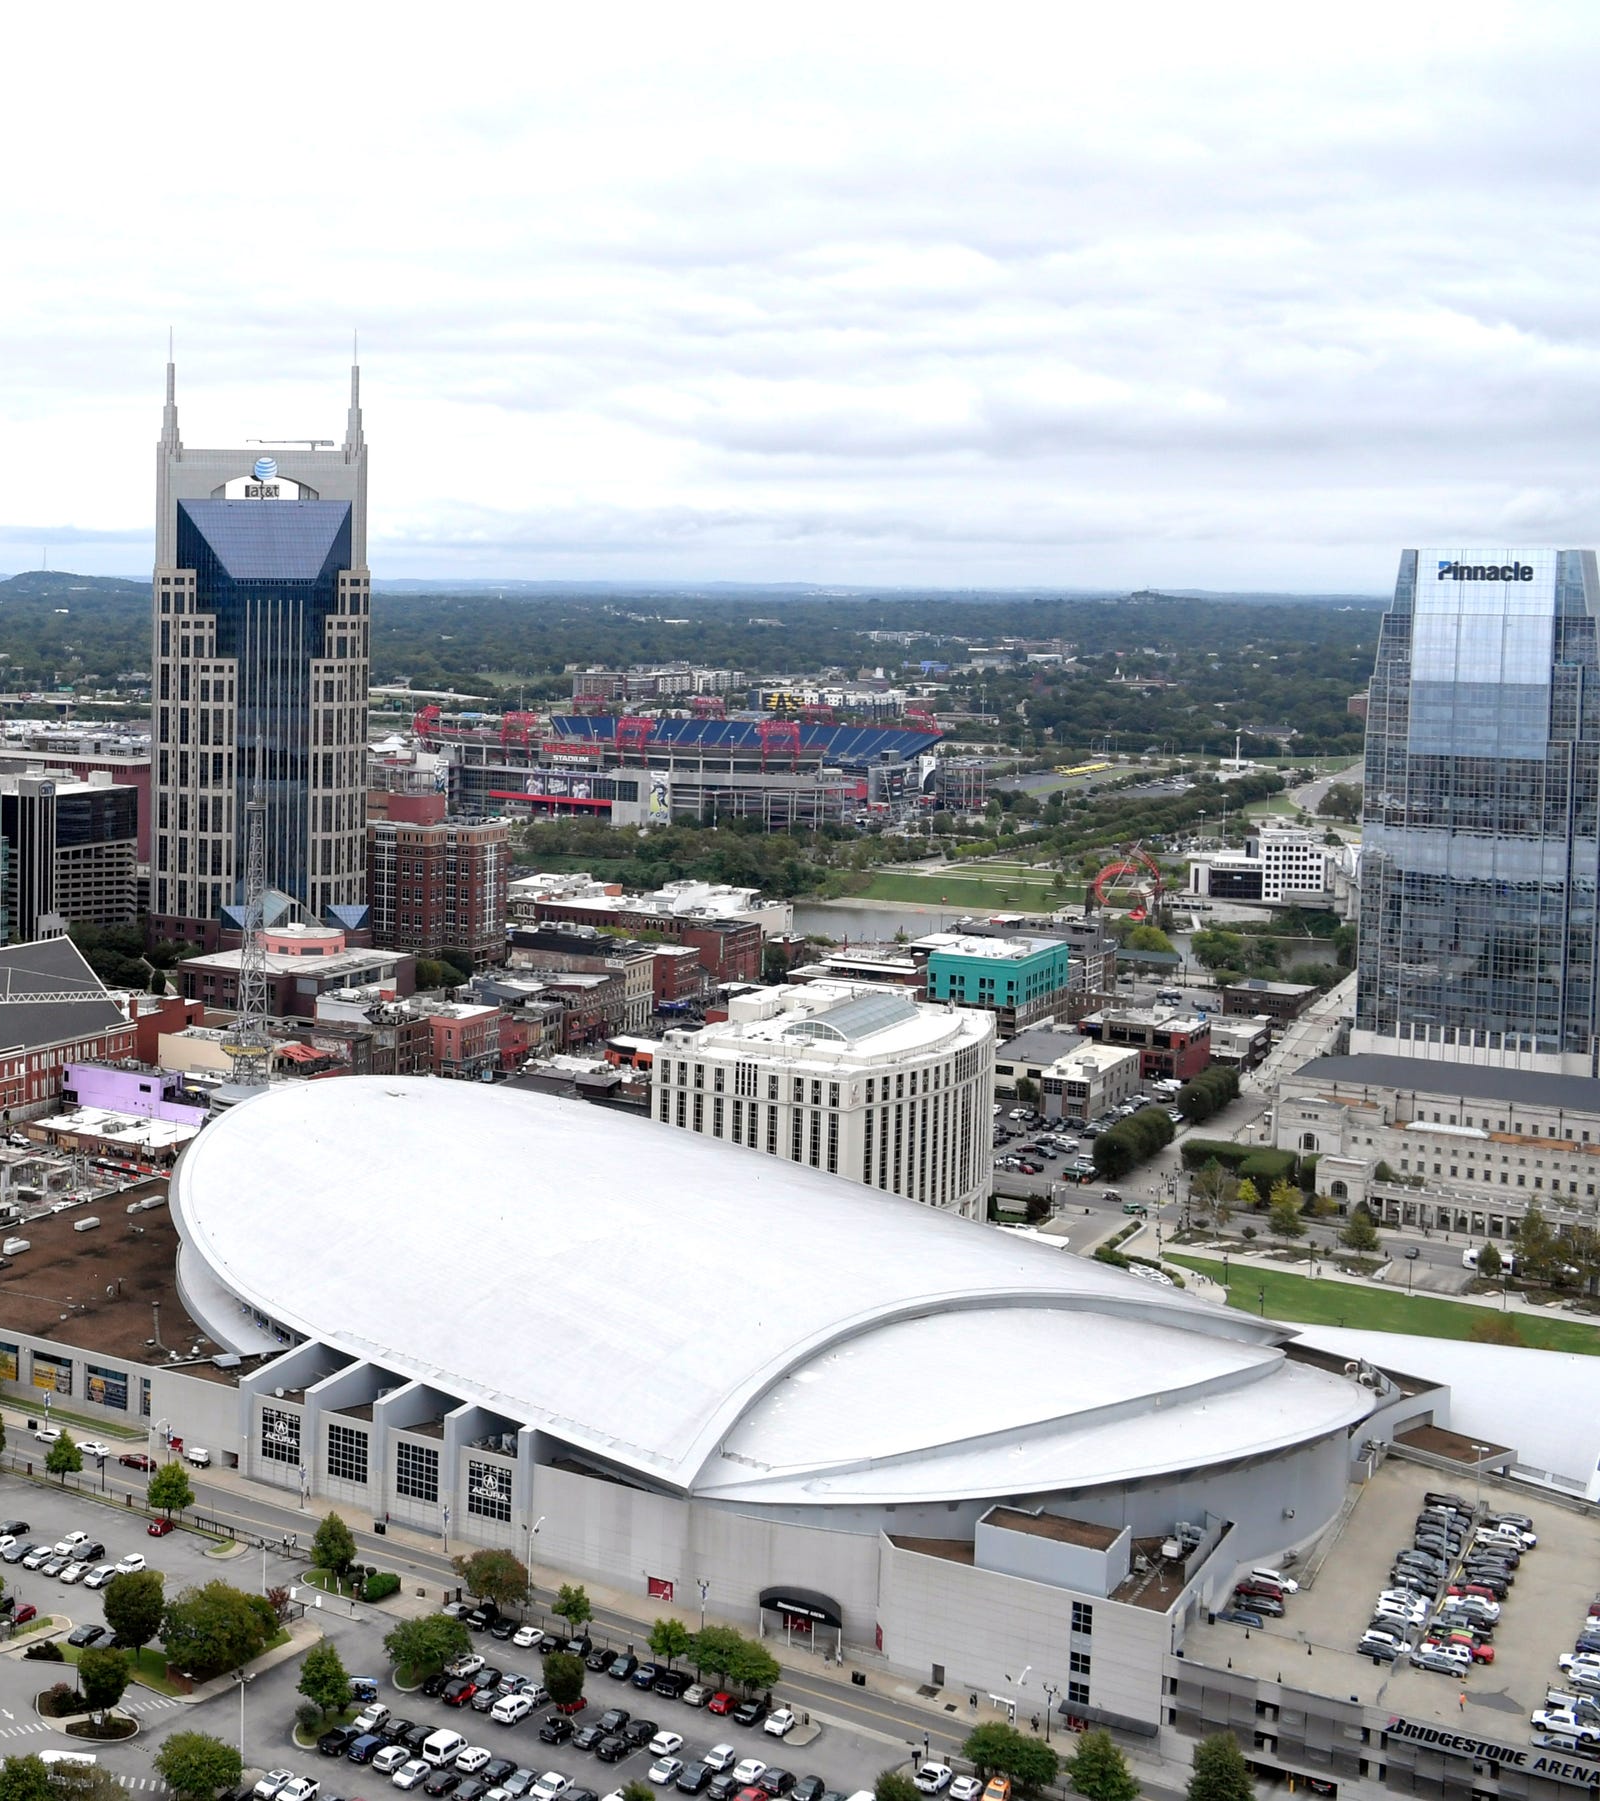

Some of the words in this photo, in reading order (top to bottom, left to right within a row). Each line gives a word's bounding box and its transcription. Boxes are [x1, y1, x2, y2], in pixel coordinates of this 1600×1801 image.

[250, 484, 280, 498] at&t
[1438, 560, 1534, 581] Pinnacle
[543, 743, 601, 755] NISSAN
[552, 754, 590, 763] STADIUM
[265, 1432, 298, 1446] ACURA
[472, 1486, 509, 1501] ACURA
[1385, 1717, 1529, 1766] BRIDGESTONE
[1533, 1757, 1600, 1786] ARENA
